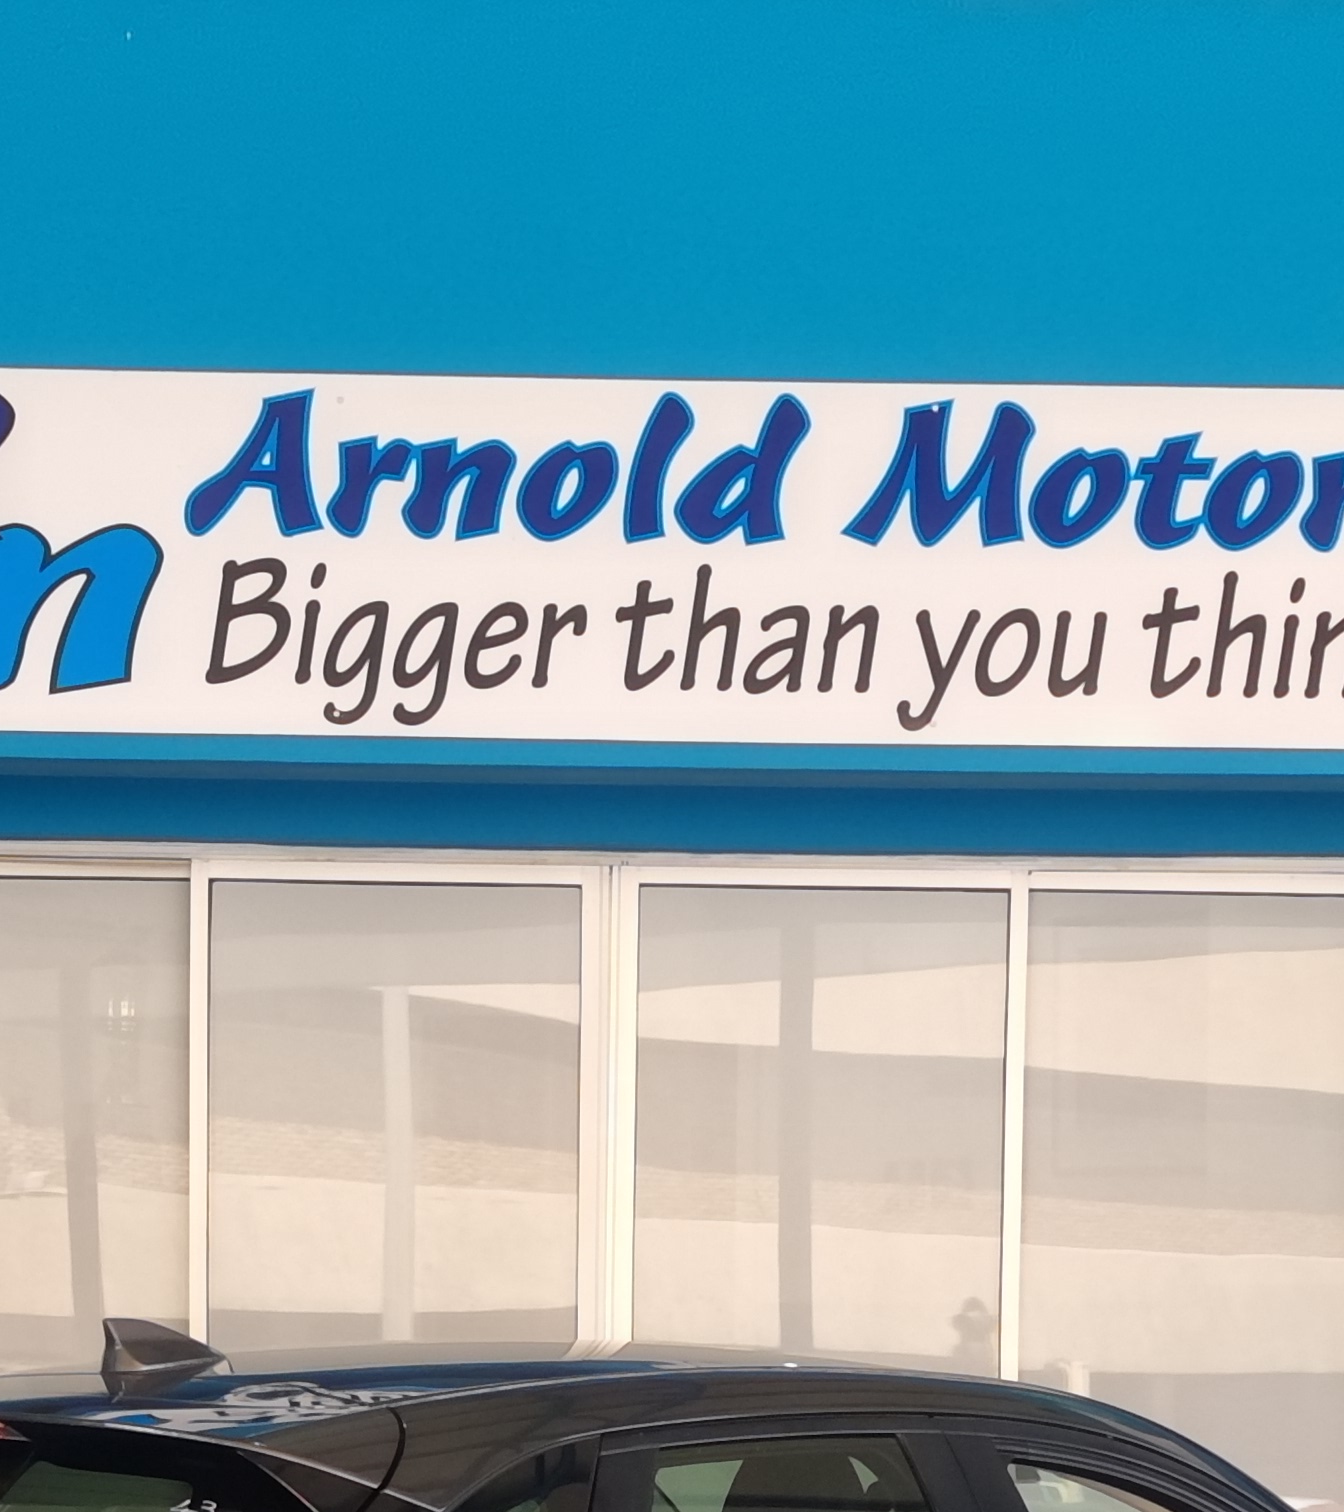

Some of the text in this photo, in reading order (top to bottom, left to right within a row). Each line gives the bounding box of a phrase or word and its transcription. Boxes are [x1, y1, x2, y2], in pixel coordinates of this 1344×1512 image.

[185, 388, 810, 545] Arnold
[205, 557, 587, 725] Bigger
[618, 563, 879, 693] than
[896, 607, 1107, 731] you
